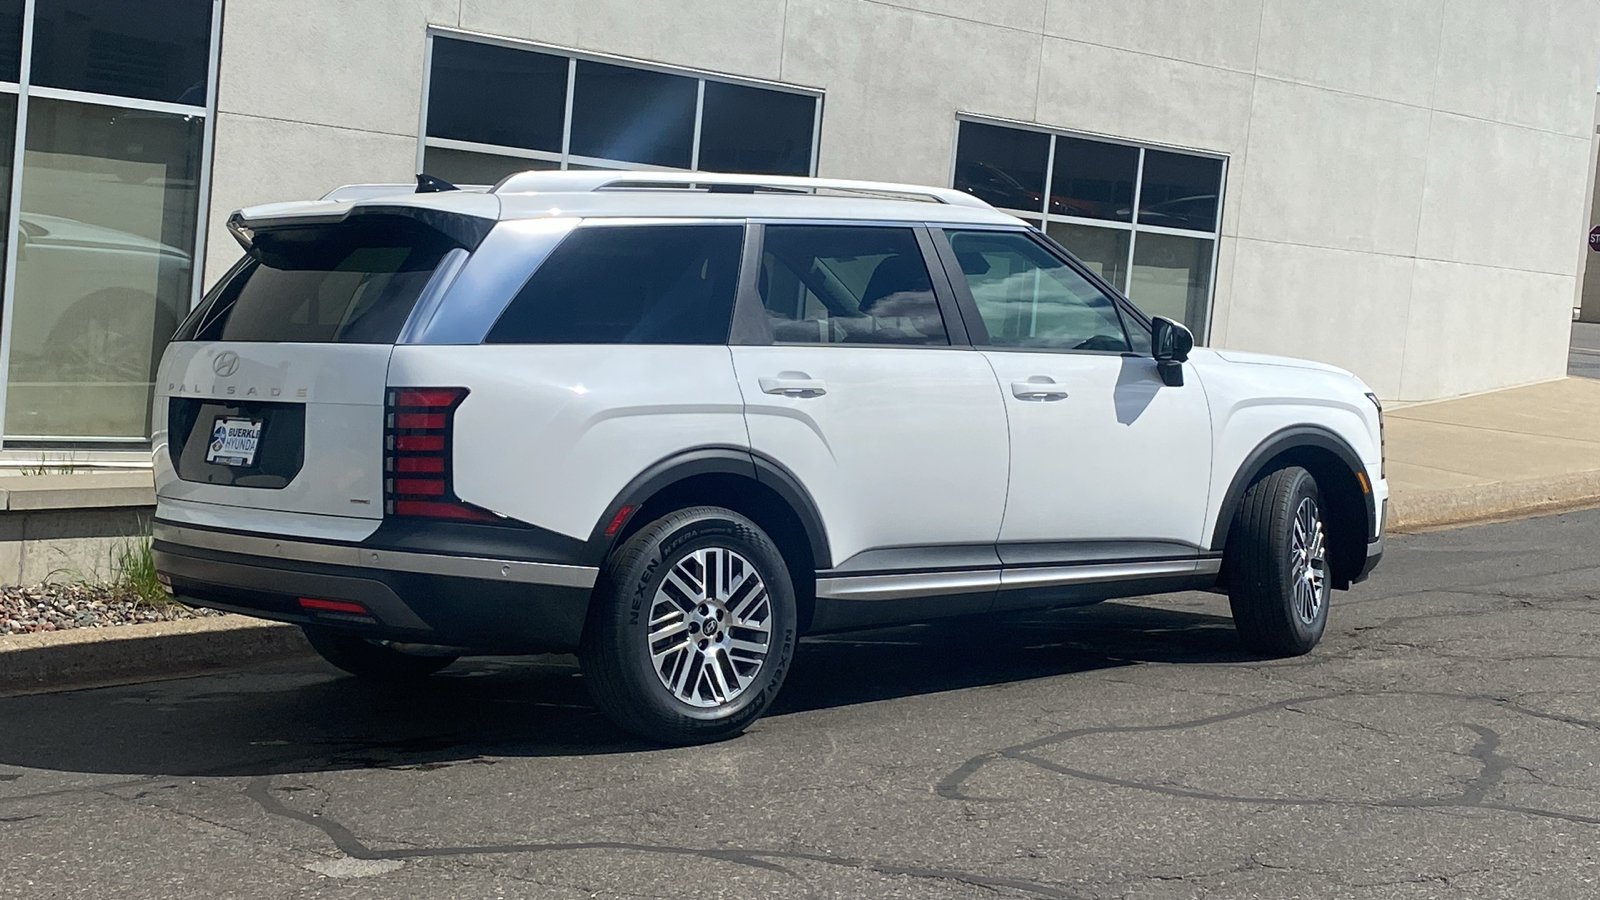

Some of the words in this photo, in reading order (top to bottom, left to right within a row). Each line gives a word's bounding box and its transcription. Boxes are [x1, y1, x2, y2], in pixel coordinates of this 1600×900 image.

[1590, 233, 1600, 243] ST
[168, 383, 307, 398] PALISADE
[630, 558, 659, 625] NEXEN
[768, 629, 793, 693] NEXEN
